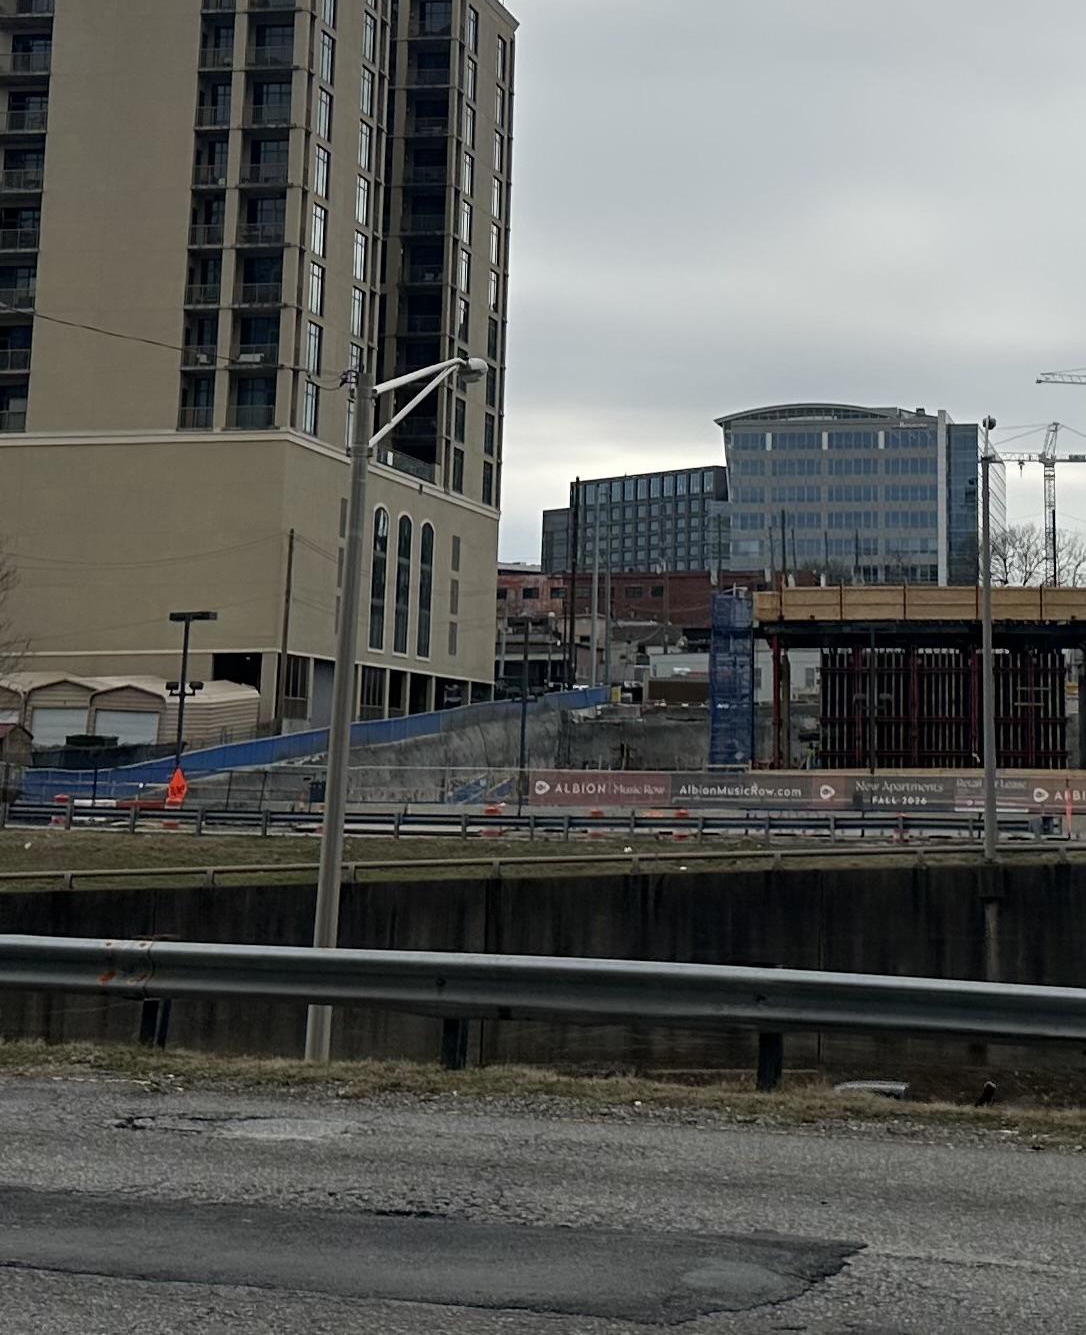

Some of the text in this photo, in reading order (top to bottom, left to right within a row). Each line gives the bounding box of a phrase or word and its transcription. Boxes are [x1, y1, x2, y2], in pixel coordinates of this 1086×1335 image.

[554, 782, 666, 795] ALBION Music Row
[679, 783, 802, 798] AlbionMusicRow.com
[855, 780, 944, 794] New Apartments
[871, 795, 897, 805] FALL
